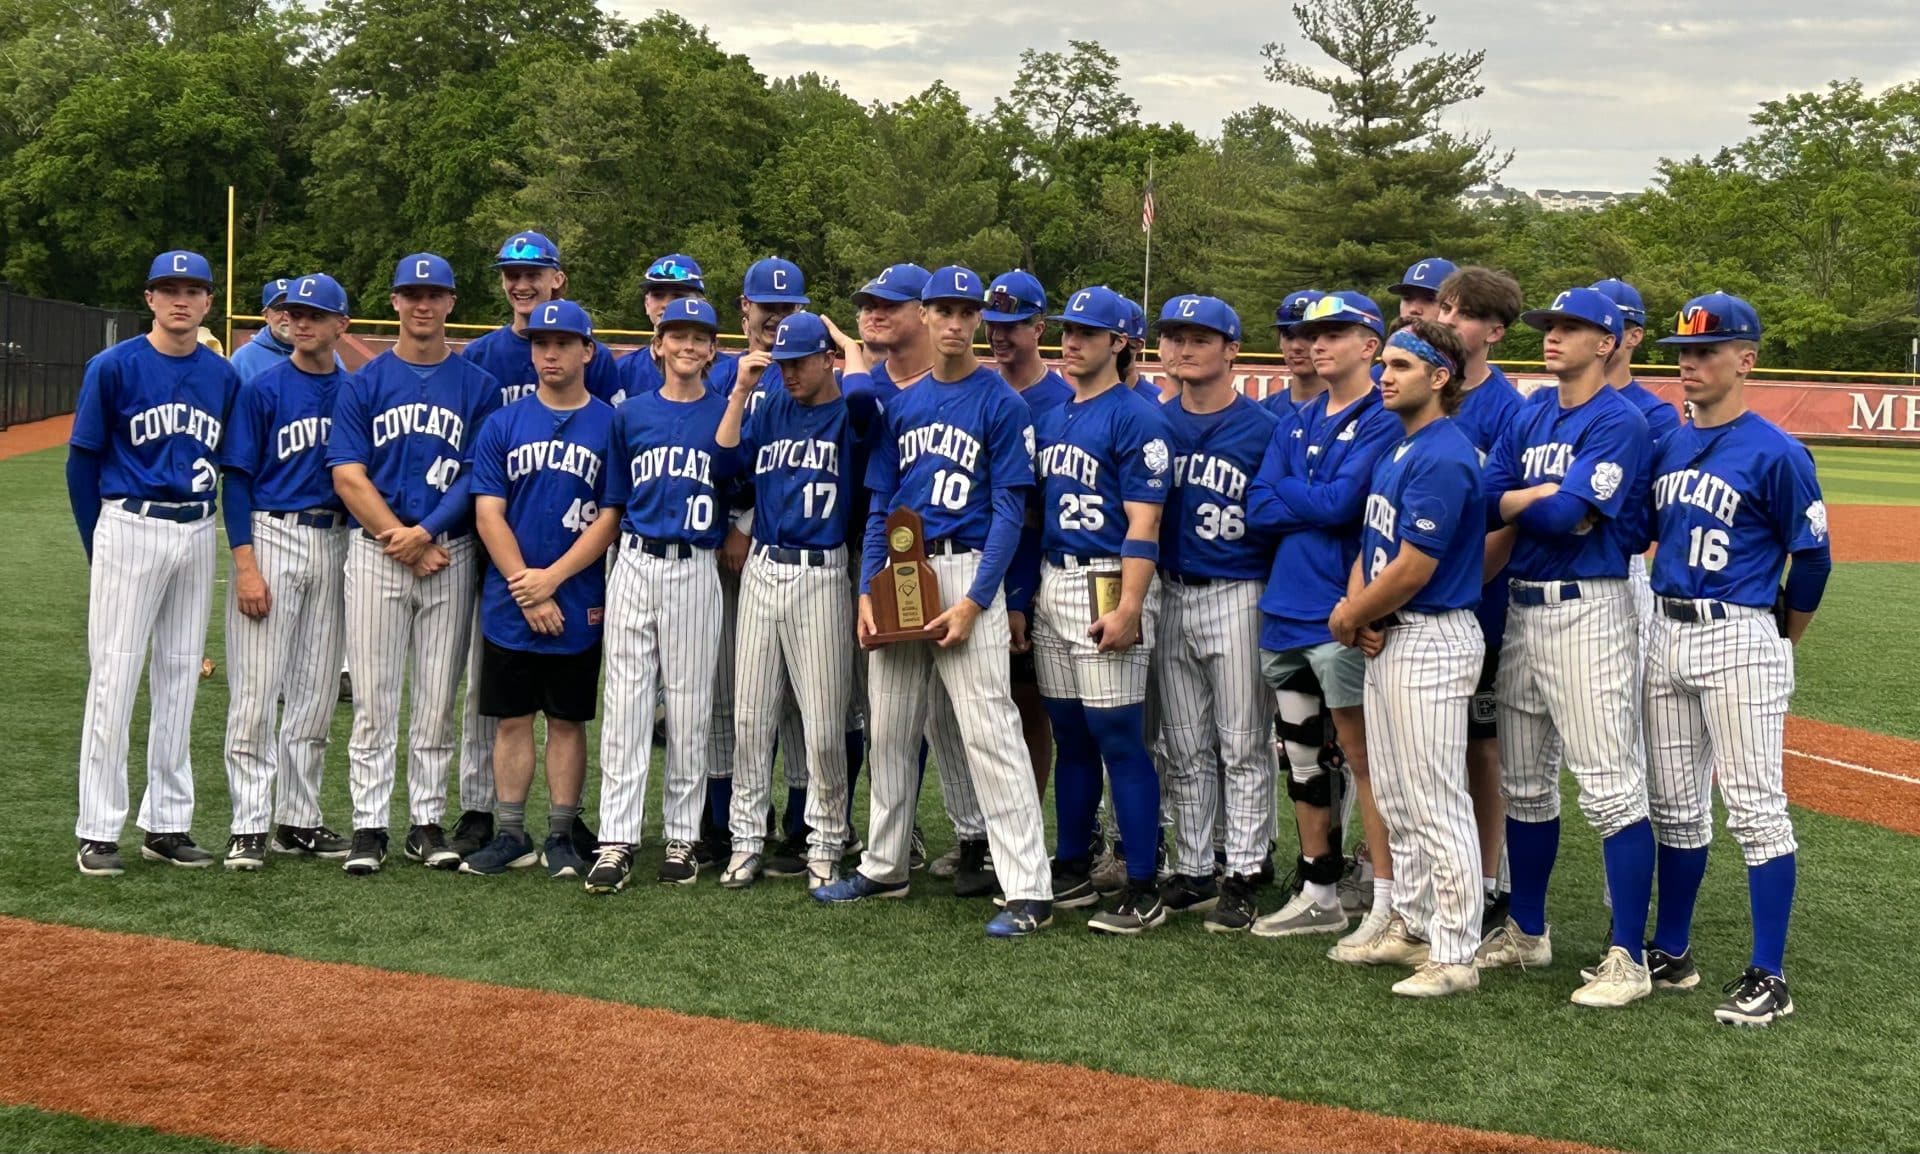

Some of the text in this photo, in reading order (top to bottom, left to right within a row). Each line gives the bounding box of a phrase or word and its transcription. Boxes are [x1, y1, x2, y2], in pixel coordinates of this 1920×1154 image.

[173, 255, 188, 273] C
[416, 260, 431, 278] C
[774, 270, 787, 290] C
[877, 268, 893, 284] C
[955, 272, 968, 291] C
[1412, 263, 1430, 280] C
[276, 279, 288, 290] C
[299, 279, 316, 297] C
[1072, 292, 1091, 312] C
[1550, 291, 1571, 311] C
[544, 305, 559, 324] C
[685, 299, 699, 315] C
[775, 324, 789, 346] C
[130, 403, 221, 452] COVCATH
[373, 402, 464, 453] COVCATH
[507, 439, 602, 491] COVCATH
[755, 438, 840, 477] COVCATH
[898, 422, 981, 474] COVCATH
[425, 455, 461, 493] 40
[1038, 443, 1099, 491] VCATH
[802, 482, 838, 519] 17
[930, 469, 971, 510] 10
[1651, 468, 1741, 528] OVCATH
[561, 497, 599, 533] 49
[683, 494, 714, 531] 10
[1059, 493, 1105, 531] 25
[1195, 502, 1246, 541] 36
[1688, 525, 1731, 572] 16
